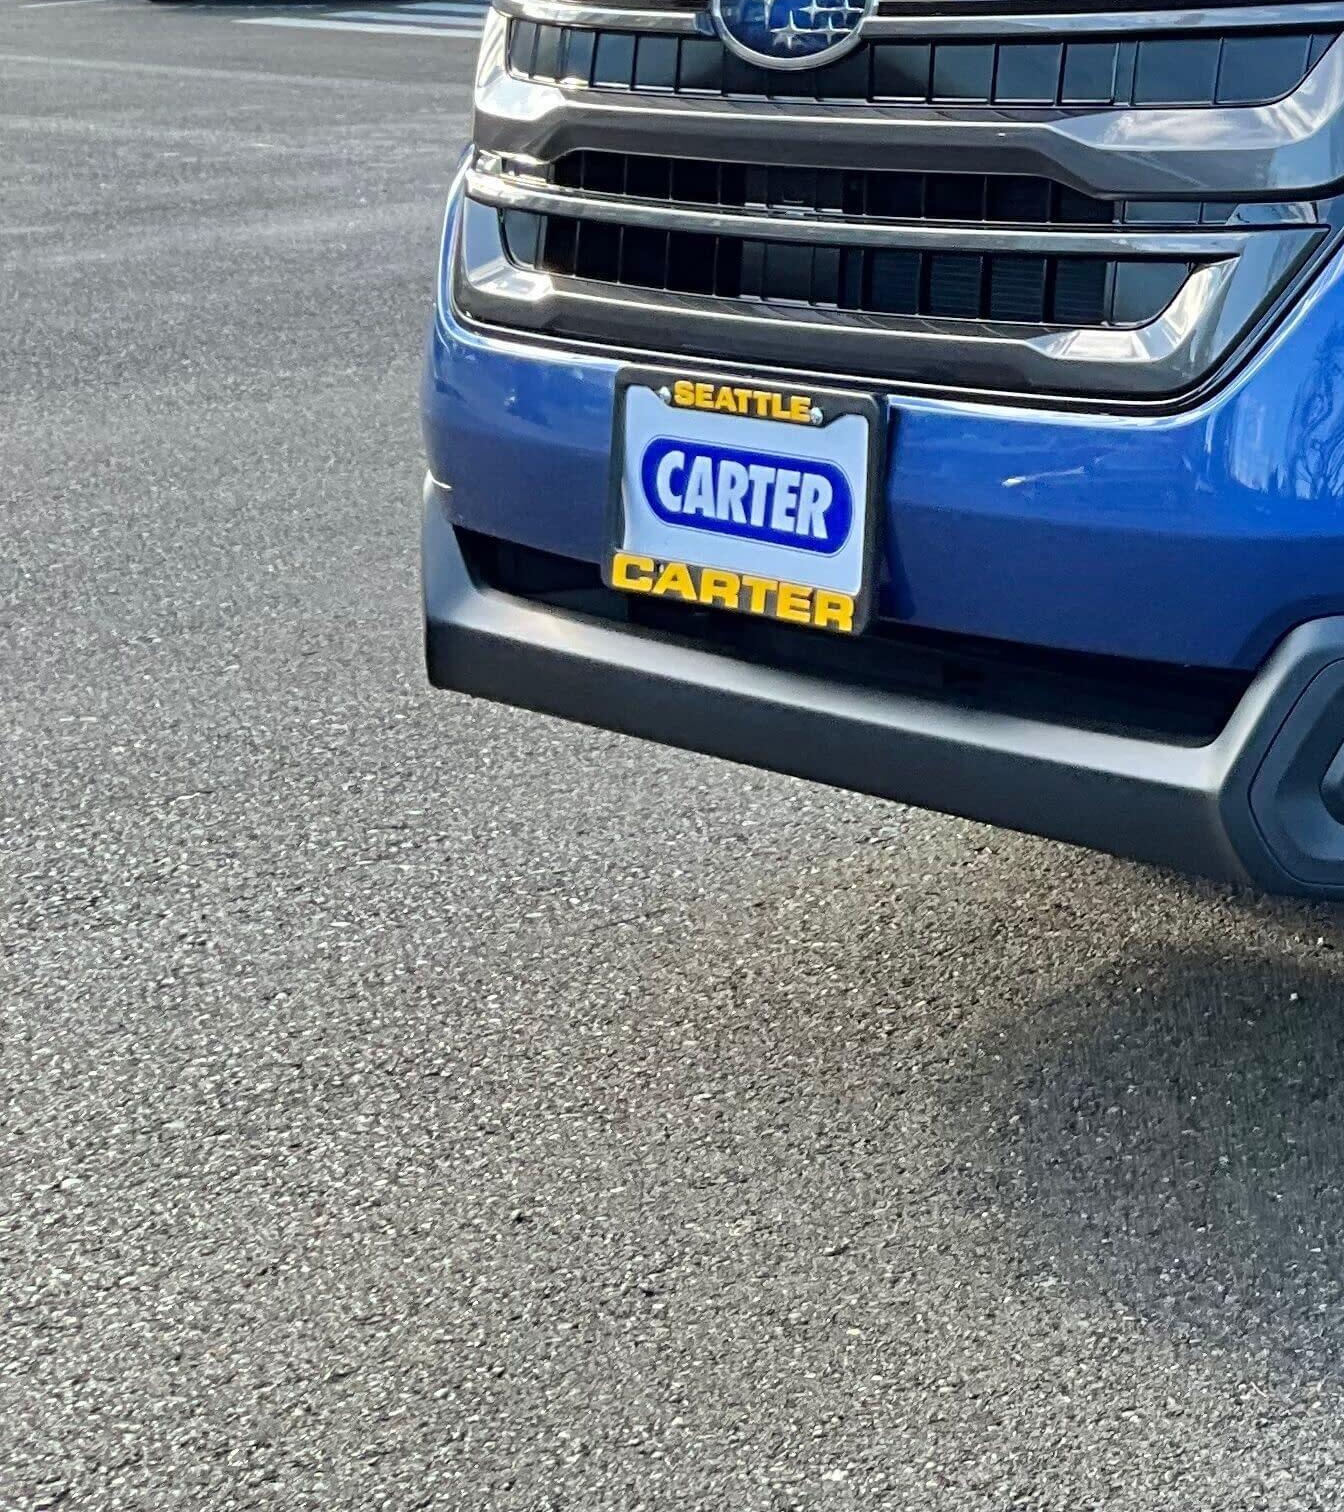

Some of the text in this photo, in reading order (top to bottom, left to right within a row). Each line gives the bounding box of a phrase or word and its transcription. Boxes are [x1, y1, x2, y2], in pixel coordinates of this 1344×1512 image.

[674, 380, 812, 423] SEATTLE
[655, 450, 833, 539] CARTER
[611, 552, 855, 632] CARTER
